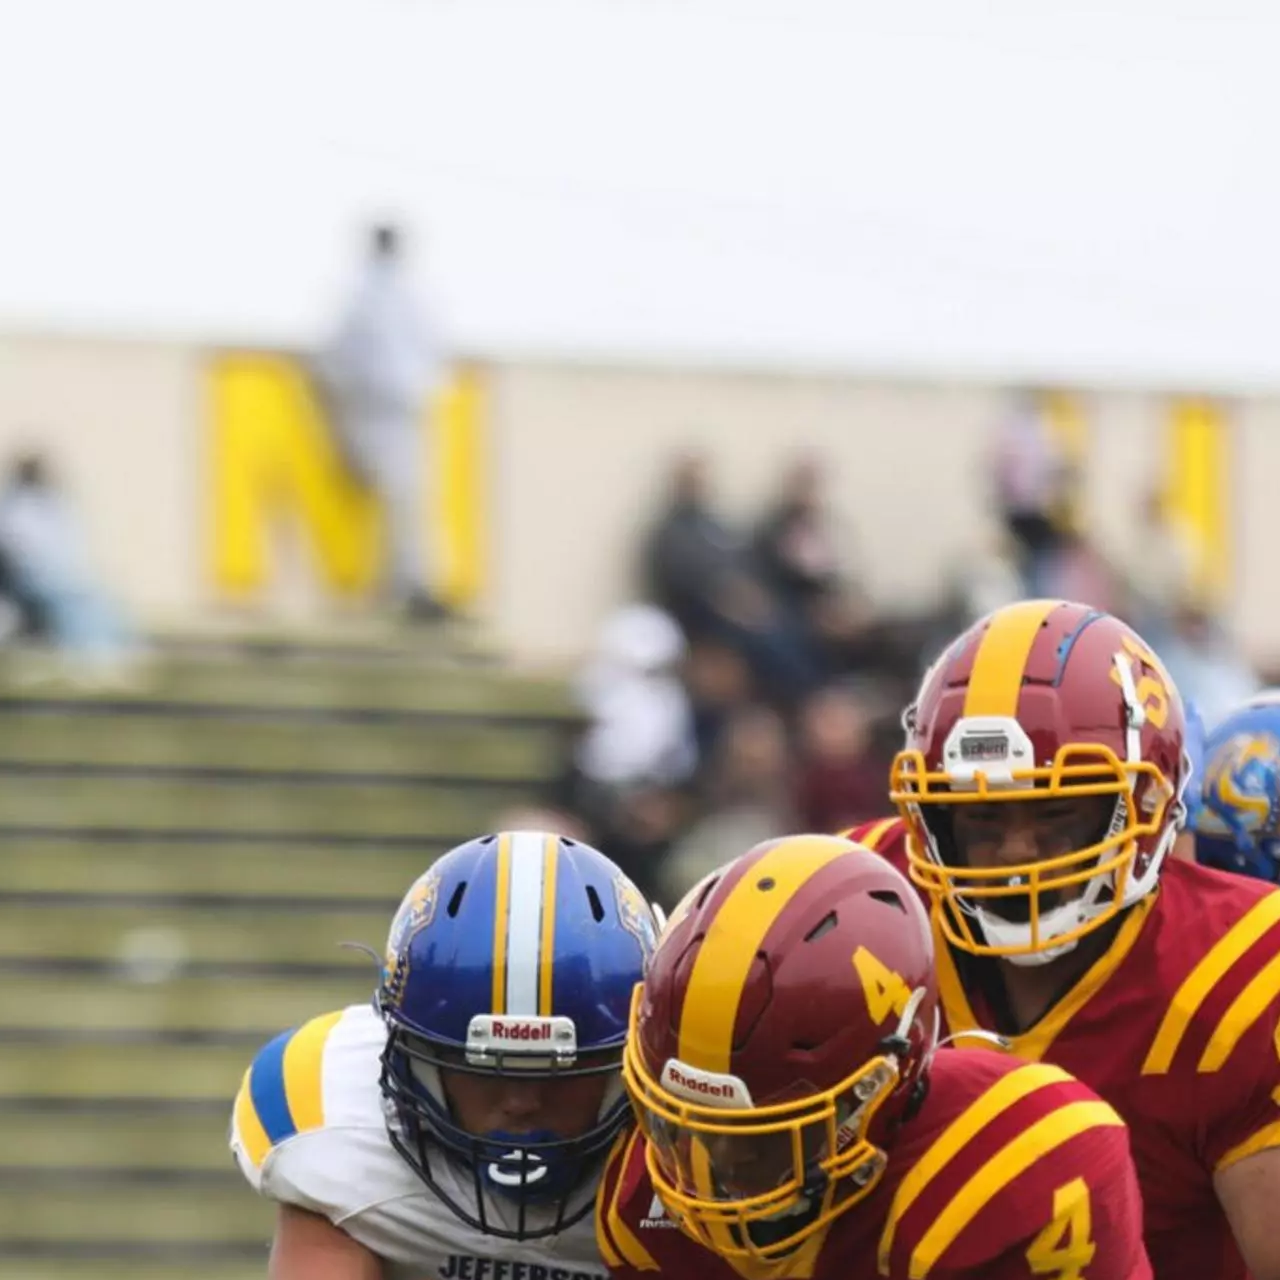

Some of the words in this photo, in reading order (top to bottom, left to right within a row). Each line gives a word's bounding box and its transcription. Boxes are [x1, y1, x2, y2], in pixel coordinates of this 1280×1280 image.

[206, 350, 486, 600] N
[852, 945, 916, 1025] 4
[491, 1020, 552, 1042] Riddell
[668, 1067, 735, 1100] Riddell
